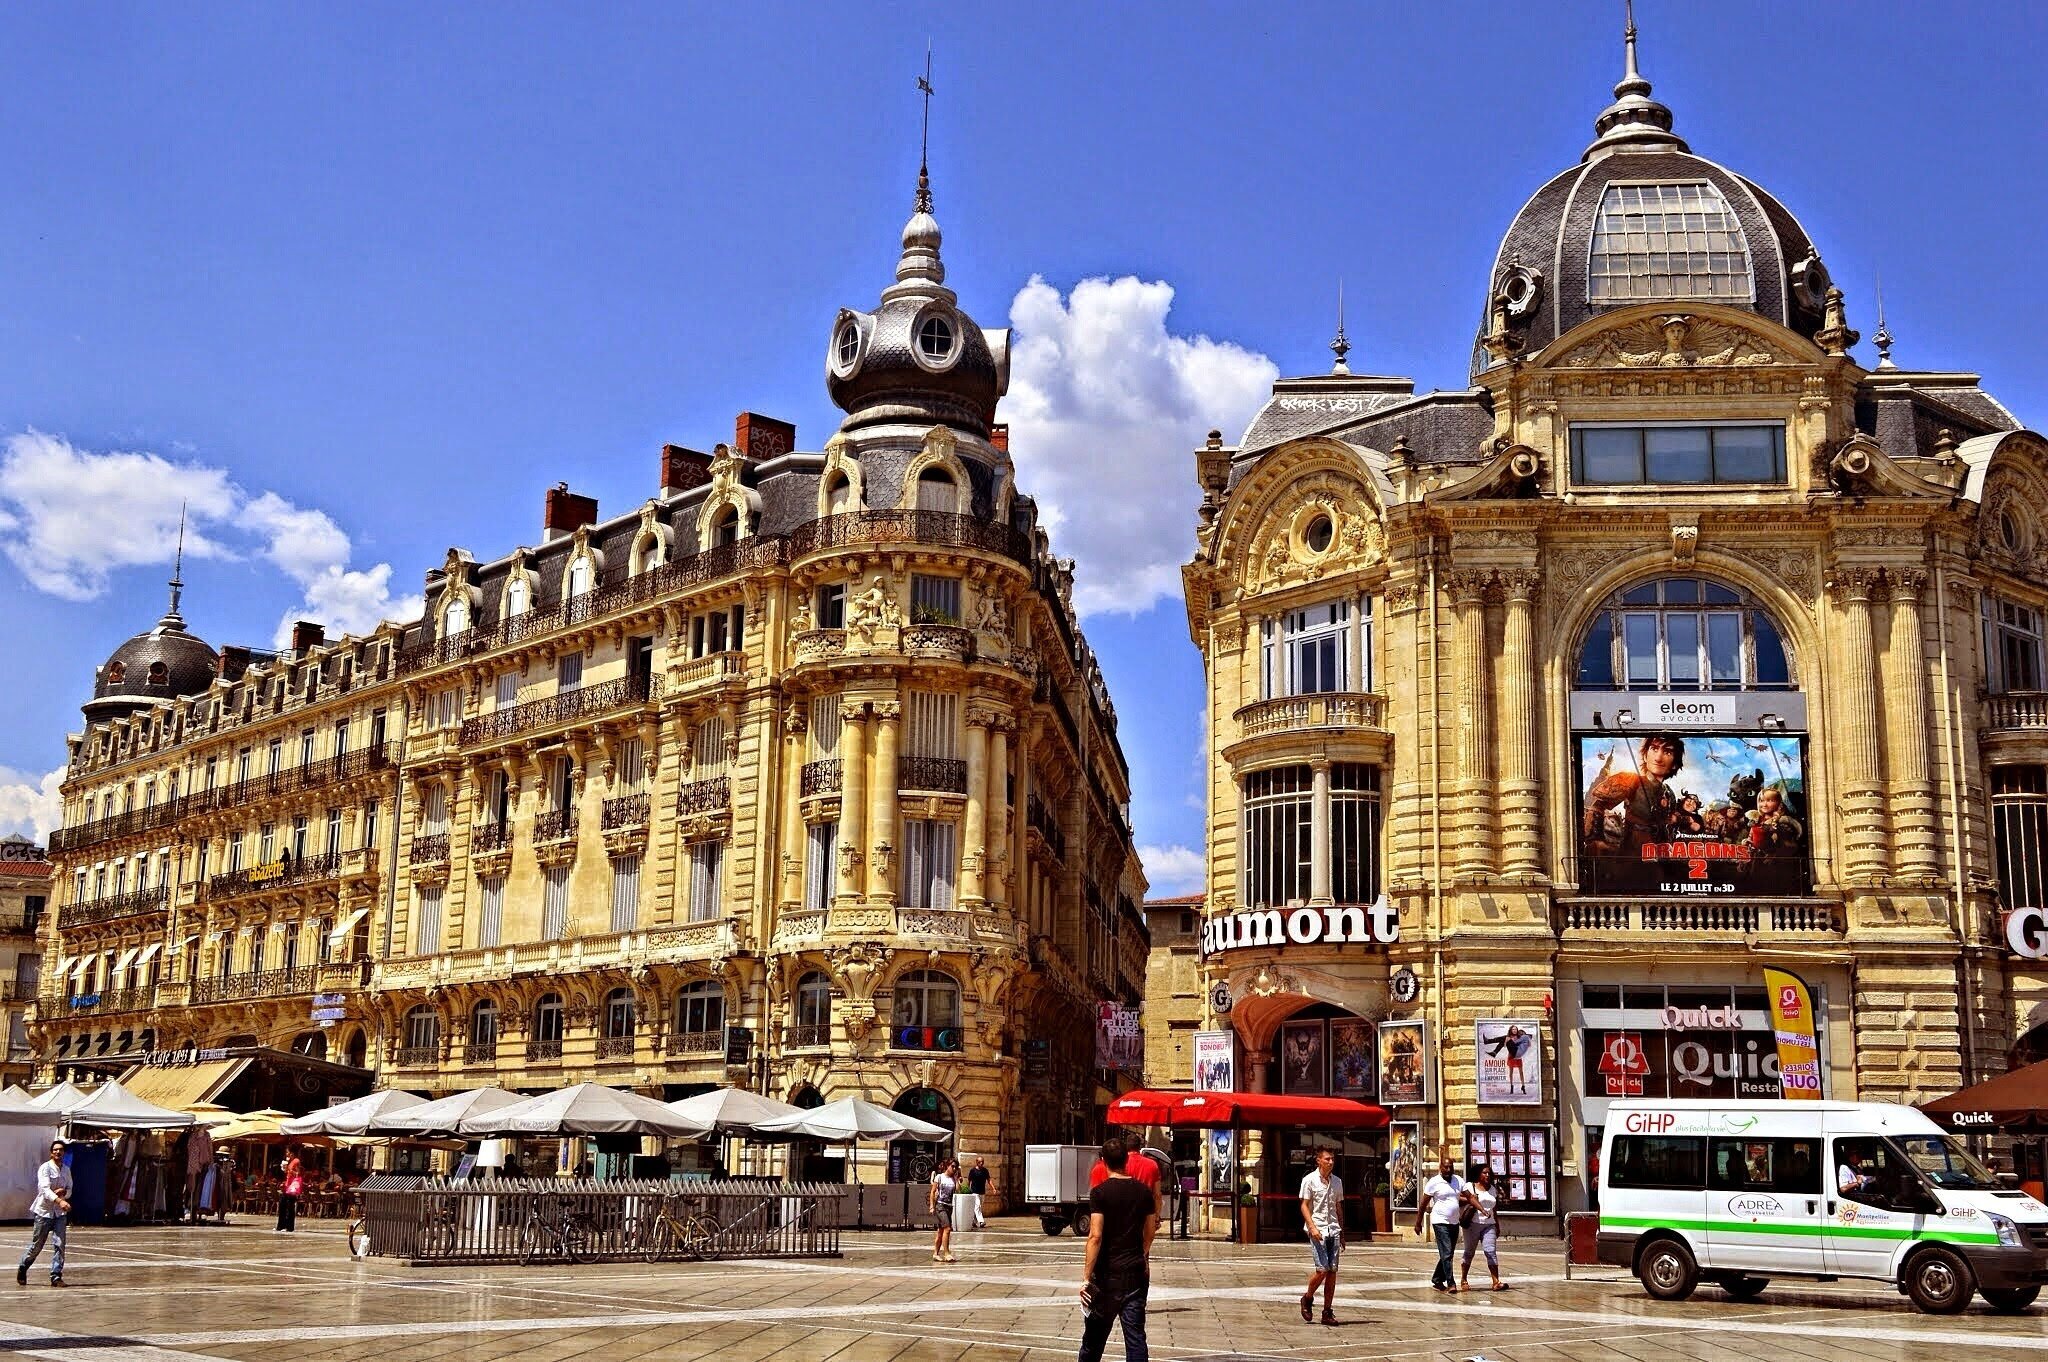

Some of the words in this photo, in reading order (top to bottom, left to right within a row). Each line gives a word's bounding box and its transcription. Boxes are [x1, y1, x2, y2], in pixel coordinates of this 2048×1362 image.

[1660, 698, 1715, 714] eleom
[1642, 842, 1751, 861] DRAGONS
[1688, 859, 1708, 879] 2
[1660, 883, 1672, 892] LE
[1673, 883, 1680, 892] 2
[1680, 883, 1712, 893] JUILLET
[1721, 883, 1735, 892] 3D
[1203, 894, 1400, 955] aumont
[1112, 1011, 1139, 1020] MONT
[1662, 1005, 1742, 1032] Quick
[1102, 1019, 1139, 1029] PELLIER
[900, 1026, 957, 1051] CIC
[1108, 1027, 1139, 1037] DANSE
[1672, 1040, 1779, 1086] Quic
[1608, 1077, 1641, 1087] Quck
[1741, 1082, 1779, 1093] Resta
[1625, 1113, 1675, 1133] GiHP
[1952, 1111, 1994, 1126] Quick
[1737, 1200, 1784, 1211] ADREA
[1951, 1207, 1976, 1217] GiHP
